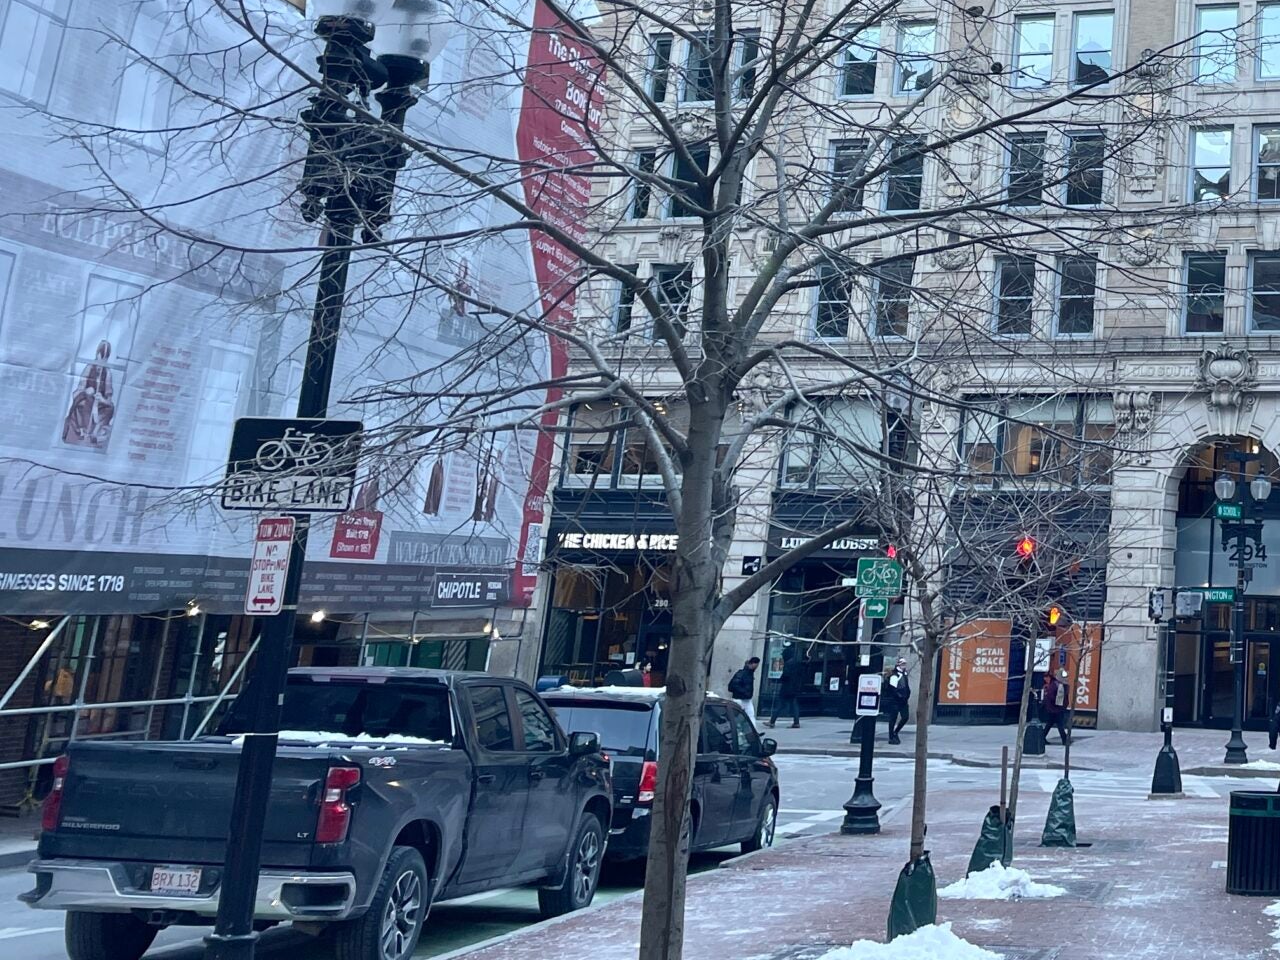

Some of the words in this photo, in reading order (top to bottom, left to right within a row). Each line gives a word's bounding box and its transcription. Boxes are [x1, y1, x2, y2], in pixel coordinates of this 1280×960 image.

[230, 479, 280, 503] BIKE
[291, 480, 343, 505] LANE
[0, 476, 148, 546] UNCH
[259, 524, 272, 538] TOW
[274, 523, 291, 538] ZONE
[583, 534, 635, 550] CHICKEN
[637, 534, 648, 550] &
[649, 535, 679, 551] RICE
[1229, 544, 1267, 562] 294
[58, 574, 95, 591] SINCE
[98, 575, 125, 592] 1718
[260, 573, 275, 583] BIKE
[257, 583, 274, 594] LANE
[438, 581, 482, 599] CHIPOTLE
[976, 647, 1005, 656] RETAIL
[975, 656, 1004, 666] SPACE
[946, 670, 960, 699] 294
[1076, 675, 1090, 705] 294
[177, 873, 198, 888] 132
